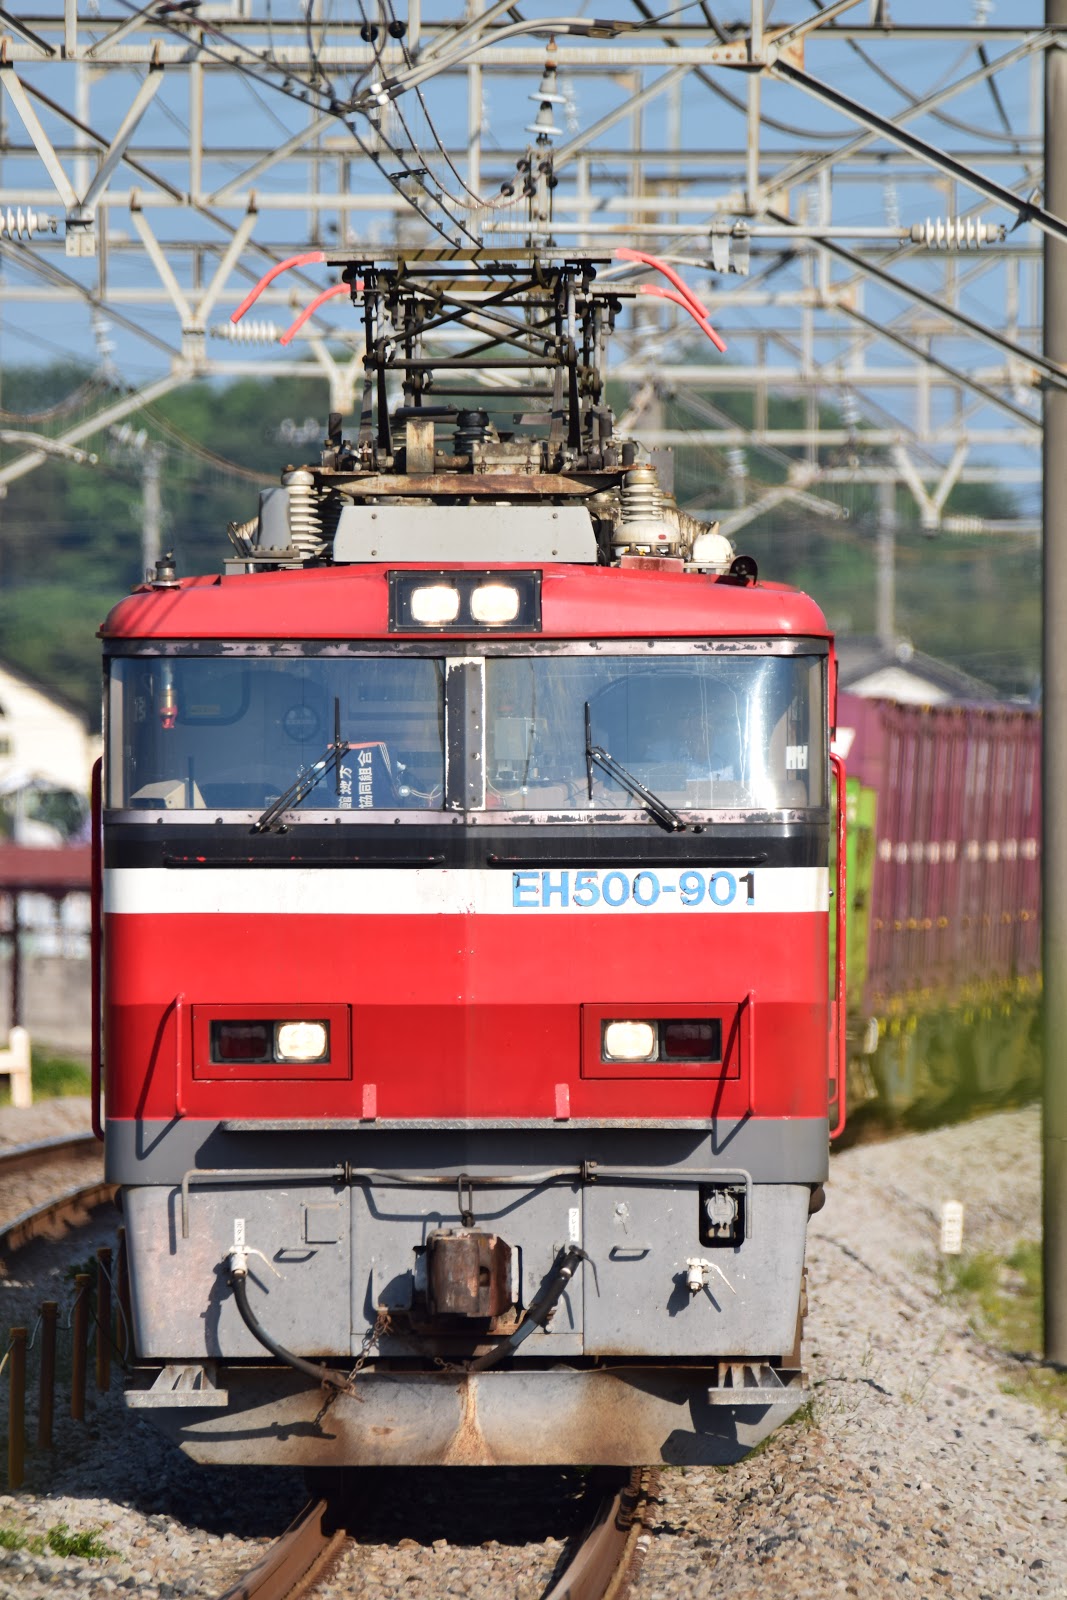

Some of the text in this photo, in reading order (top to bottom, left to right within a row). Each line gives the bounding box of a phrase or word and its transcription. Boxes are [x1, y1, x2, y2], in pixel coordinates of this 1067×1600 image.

[357, 750, 374, 809] 協同組合
[513, 870, 755, 907] EH500-901
